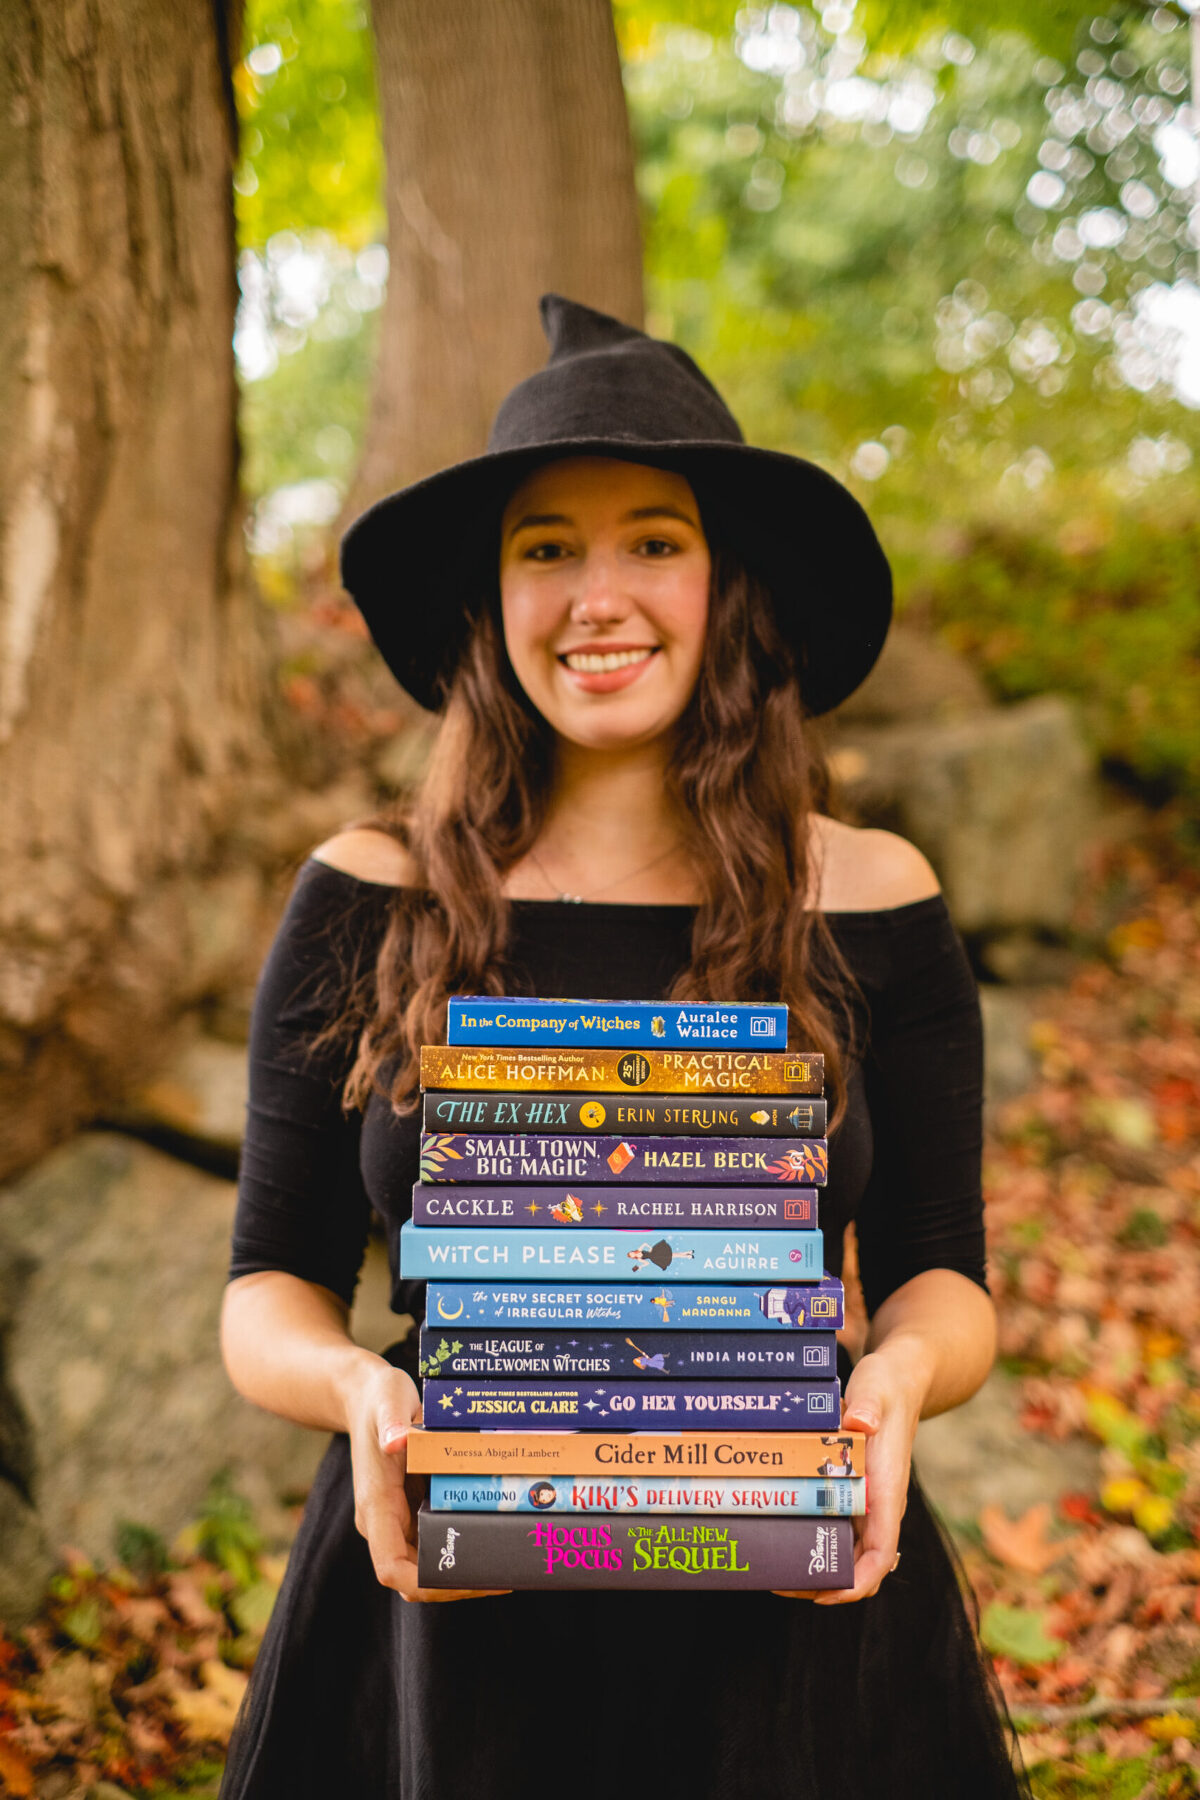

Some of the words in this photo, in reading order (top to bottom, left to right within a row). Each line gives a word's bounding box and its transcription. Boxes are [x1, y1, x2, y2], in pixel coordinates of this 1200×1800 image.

[461, 1014, 477, 1027] In
[479, 1018, 493, 1027] the
[495, 1014, 567, 1033] Company
[568, 1019, 579, 1031] of
[580, 1015, 640, 1032] Witches
[676, 1010, 738, 1024] Auralee
[676, 1025, 738, 1038] Wallace
[462, 1053, 478, 1061] New
[496, 1054, 516, 1062] Times
[518, 1054, 557, 1063] Bestselling
[558, 1055, 584, 1063] Author
[663, 1054, 772, 1071] PRACTICAL
[441, 1064, 496, 1079] ALICE
[507, 1065, 605, 1081] HOFFMAN
[684, 1072, 751, 1088] MAGIC
[436, 1101, 488, 1123] THE
[494, 1102, 522, 1124] EX
[525, 1103, 571, 1124] HEX
[617, 1107, 655, 1123] ERIN
[664, 1109, 739, 1128] STERLING
[465, 1139, 531, 1157] SMALL
[537, 1140, 600, 1159] TOWN,
[477, 1158, 512, 1175] BIG
[520, 1159, 587, 1176] MAGIC
[644, 1152, 706, 1168] HAZEL
[714, 1152, 768, 1171] BECK
[426, 1199, 514, 1216] CACKLE
[617, 1202, 684, 1216] RACHEL
[691, 1203, 777, 1216] HARRISON
[522, 1246, 616, 1264] PLEASE
[723, 1243, 759, 1255] ANN
[703, 1257, 779, 1270] AGUIRRE
[472, 1291, 488, 1302] the
[492, 1293, 527, 1303] VERY
[532, 1293, 582, 1304] SECRET
[586, 1294, 643, 1304] SOCIETY
[696, 1296, 737, 1305] SANGU
[494, 1306, 504, 1317] of
[507, 1307, 583, 1318] IRREGULAR
[586, 1307, 622, 1319] Witches
[682, 1308, 751, 1317] MANDANNA
[469, 1343, 483, 1351] THE
[485, 1340, 533, 1357] LEAGUE
[535, 1343, 545, 1351] OF
[691, 1352, 730, 1362] INDIA
[737, 1352, 795, 1362] HOLTON
[452, 1358, 550, 1372] GENTLEWOMEN
[552, 1354, 610, 1372] WITCHES
[467, 1400, 526, 1414] JESSICA
[531, 1400, 578, 1414] CLARE
[609, 1396, 635, 1411] GO
[642, 1396, 676, 1411] HEX
[684, 1395, 781, 1411] YOURSELF
[444, 1447, 482, 1457] Vanessa
[485, 1448, 518, 1460] Abigail
[521, 1448, 560, 1458] Lambert
[595, 1443, 656, 1464] Cider
[663, 1444, 708, 1464] Mill
[714, 1444, 783, 1465] Coven
[444, 1490, 468, 1502] EIKO
[472, 1490, 516, 1502] KADONO
[647, 1489, 725, 1508] DELIVERY
[732, 1490, 799, 1508] SERVICE
[627, 1527, 637, 1537] &
[637, 1527, 654, 1537] THE
[655, 1525, 729, 1544] ALL-NEW
[633, 1537, 750, 1574] SEQUEL
[830, 1526, 838, 1573] HYPERION
